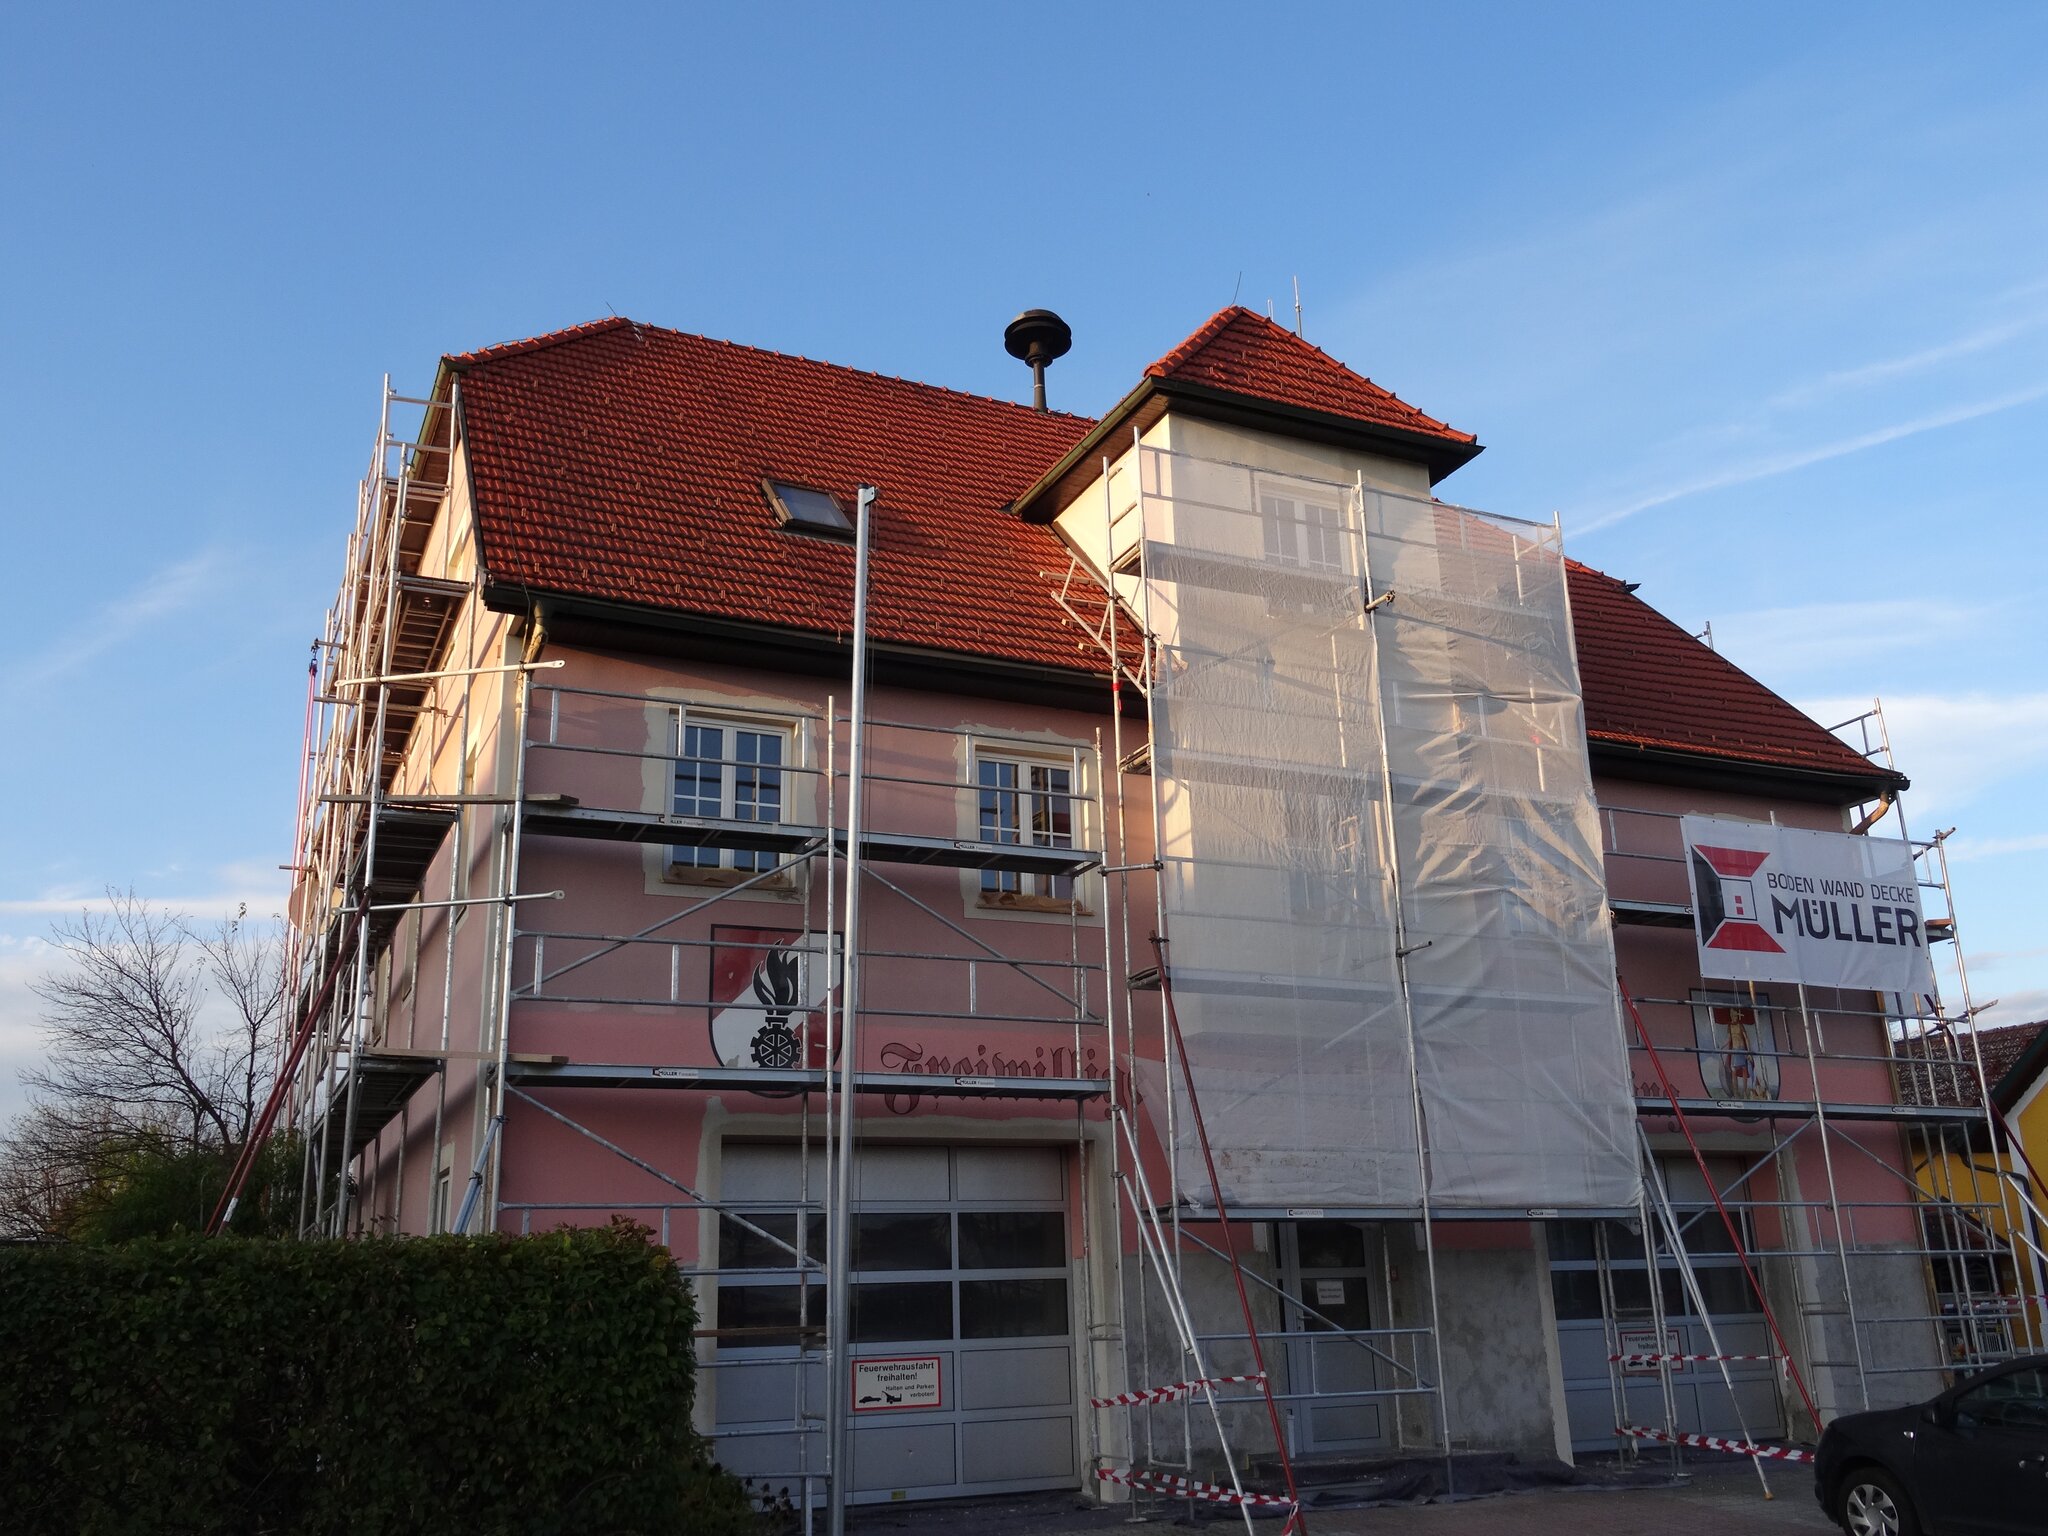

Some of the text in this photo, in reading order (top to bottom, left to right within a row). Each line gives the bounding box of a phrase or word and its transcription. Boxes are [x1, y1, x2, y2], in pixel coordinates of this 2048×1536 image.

[1767, 873, 1915, 903] BODEN WAND DECKE
[1771, 893, 1921, 948] MÜLLER
[859, 1362, 934, 1372] Feuerwehrausfahrt
[877, 1373, 917, 1381] freihalten!
